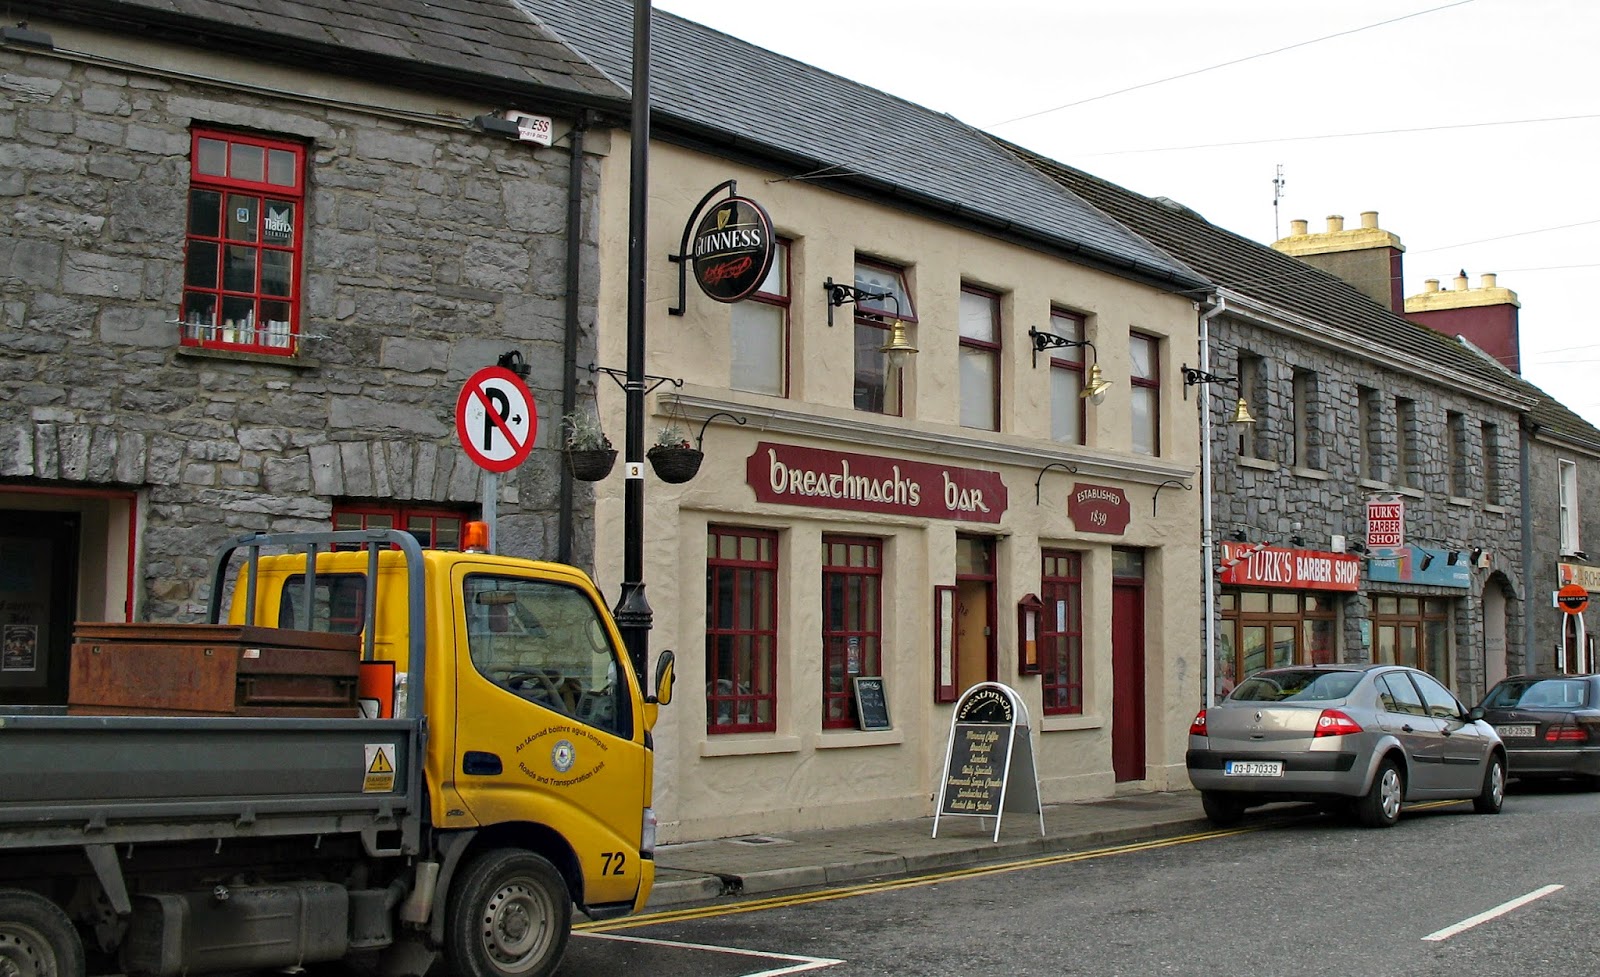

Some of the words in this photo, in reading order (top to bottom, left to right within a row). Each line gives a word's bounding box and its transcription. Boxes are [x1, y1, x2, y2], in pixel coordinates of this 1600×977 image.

[695, 229, 761, 257] GUINNESS
[631, 466, 639, 476] 3
[1077, 489, 1121, 505] ESTABLISHED
[1090, 510, 1107, 526] 1839
[1369, 506, 1400, 518] TURK'S
[1369, 521, 1400, 532] BARBER
[1369, 534, 1400, 543] SHOP
[1247, 549, 1292, 583] TURK'S
[1296, 556, 1332, 582] BARBER
[1335, 560, 1358, 584] SHOP
[516, 743, 525, 753] An
[571, 727, 587, 736] agus
[518, 762, 537, 779] Roads
[536, 775, 549, 784] and
[549, 771, 593, 787] Transportation
[592, 761, 605, 774] Unit
[1234, 764, 1278, 774] 03-D-70339
[601, 851, 626, 876] 72
